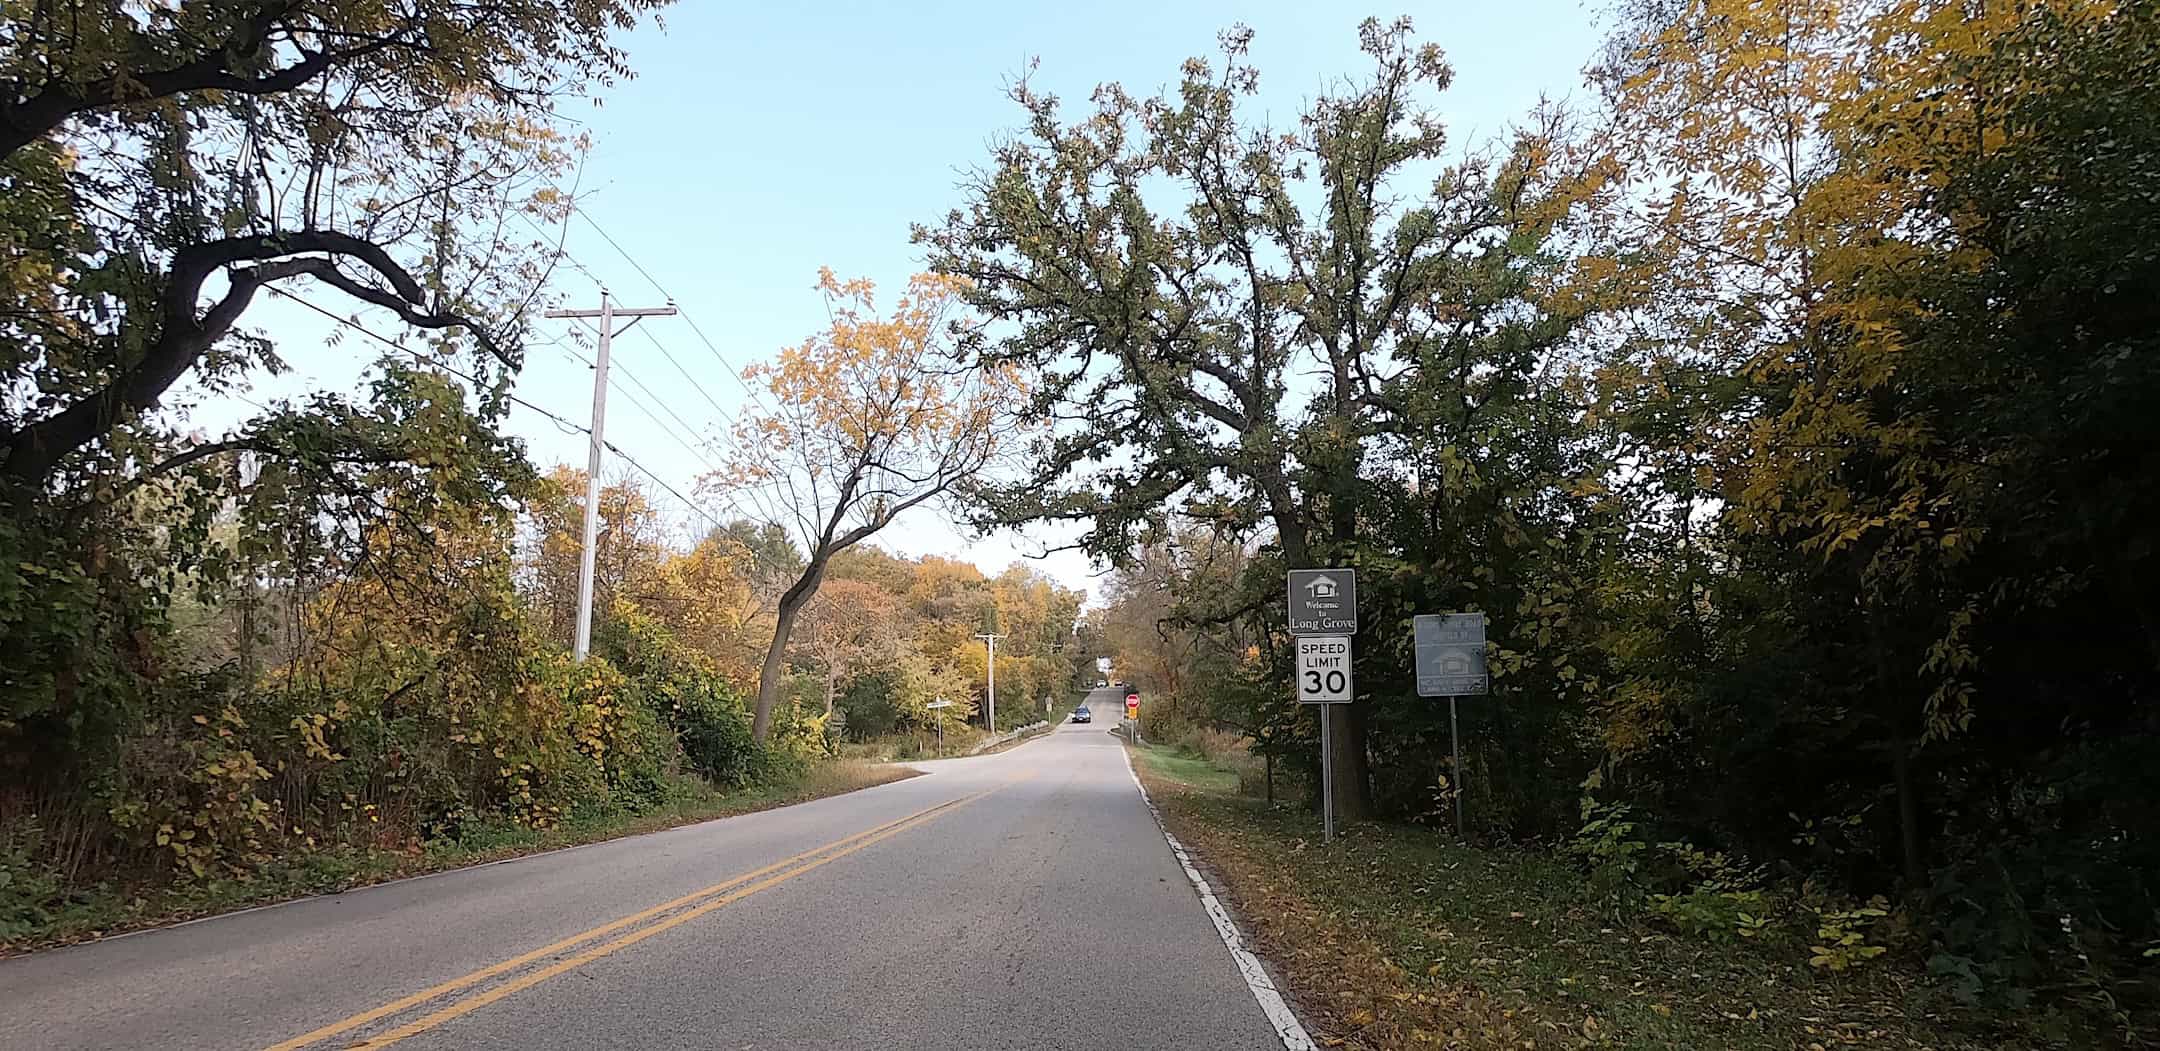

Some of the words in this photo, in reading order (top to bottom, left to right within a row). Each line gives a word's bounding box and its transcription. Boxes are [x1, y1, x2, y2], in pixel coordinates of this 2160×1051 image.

[1305, 600, 1339, 609] Welcome
[1291, 618, 1319, 630] Long
[1321, 617, 1354, 630] Grove
[1301, 643, 1346, 654] SPEED
[1306, 657, 1341, 668] LIMIT
[1304, 670, 1346, 694] 30
